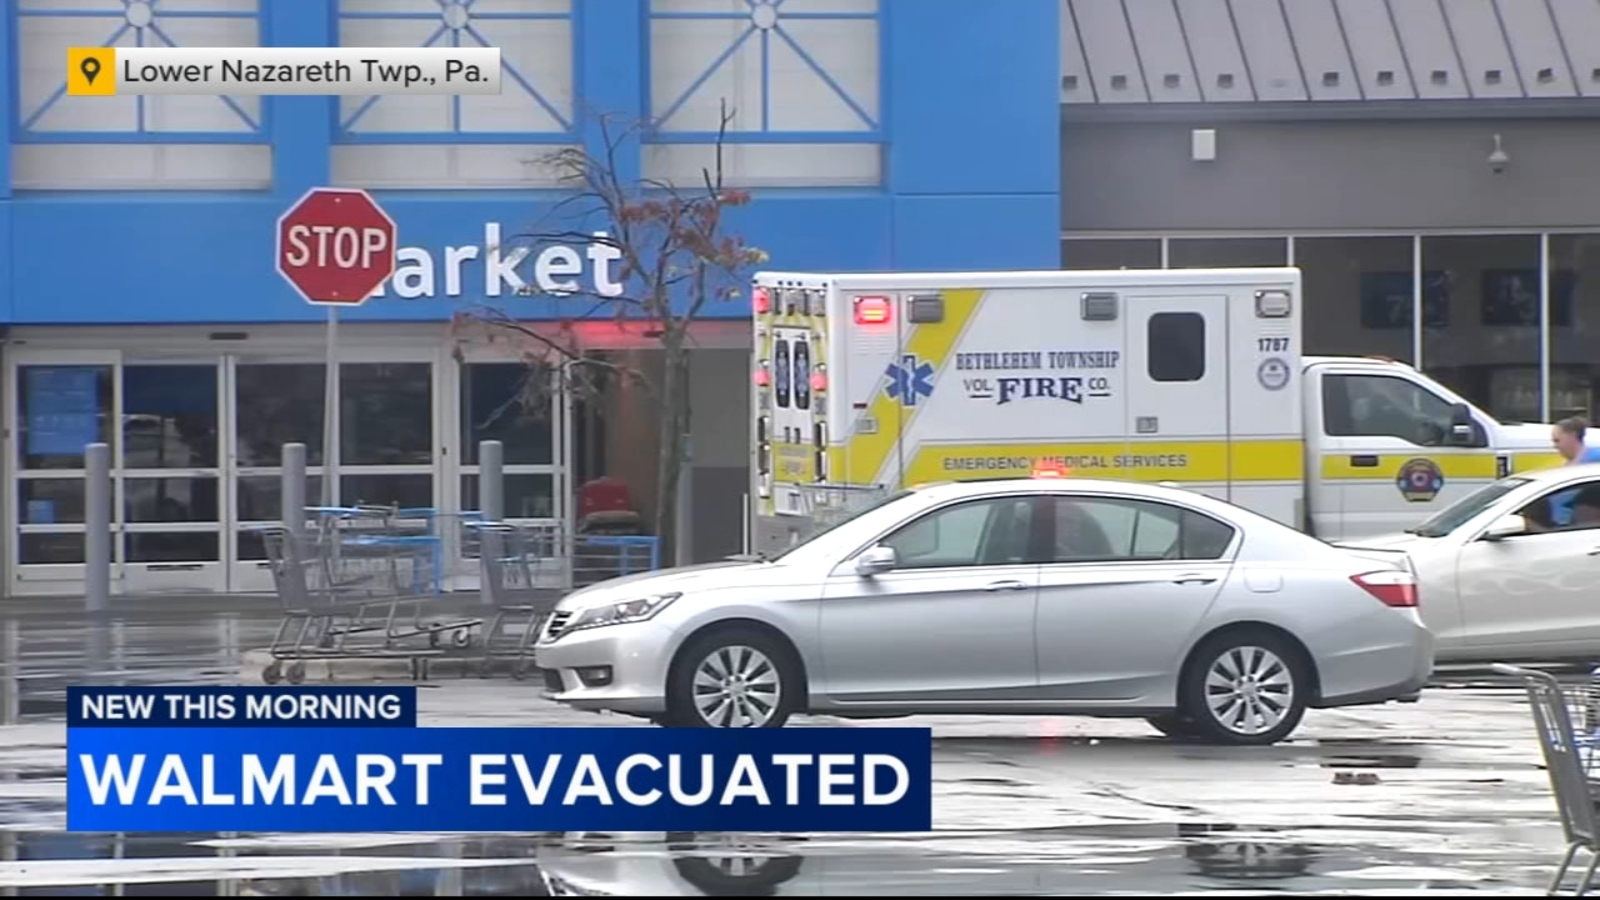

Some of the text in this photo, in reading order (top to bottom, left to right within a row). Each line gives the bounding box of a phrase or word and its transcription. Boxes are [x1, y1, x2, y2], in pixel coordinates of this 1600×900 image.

[286, 225, 387, 269] STOP
[371, 222, 624, 297] arket
[956, 350, 1119, 370] BETHLEHEM TOWNSHIP
[996, 377, 1083, 405] FIRE
[1088, 377, 1111, 391] CO.
[943, 456, 1035, 471] EMERGENCY
[1113, 454, 1187, 468] SERVICES
